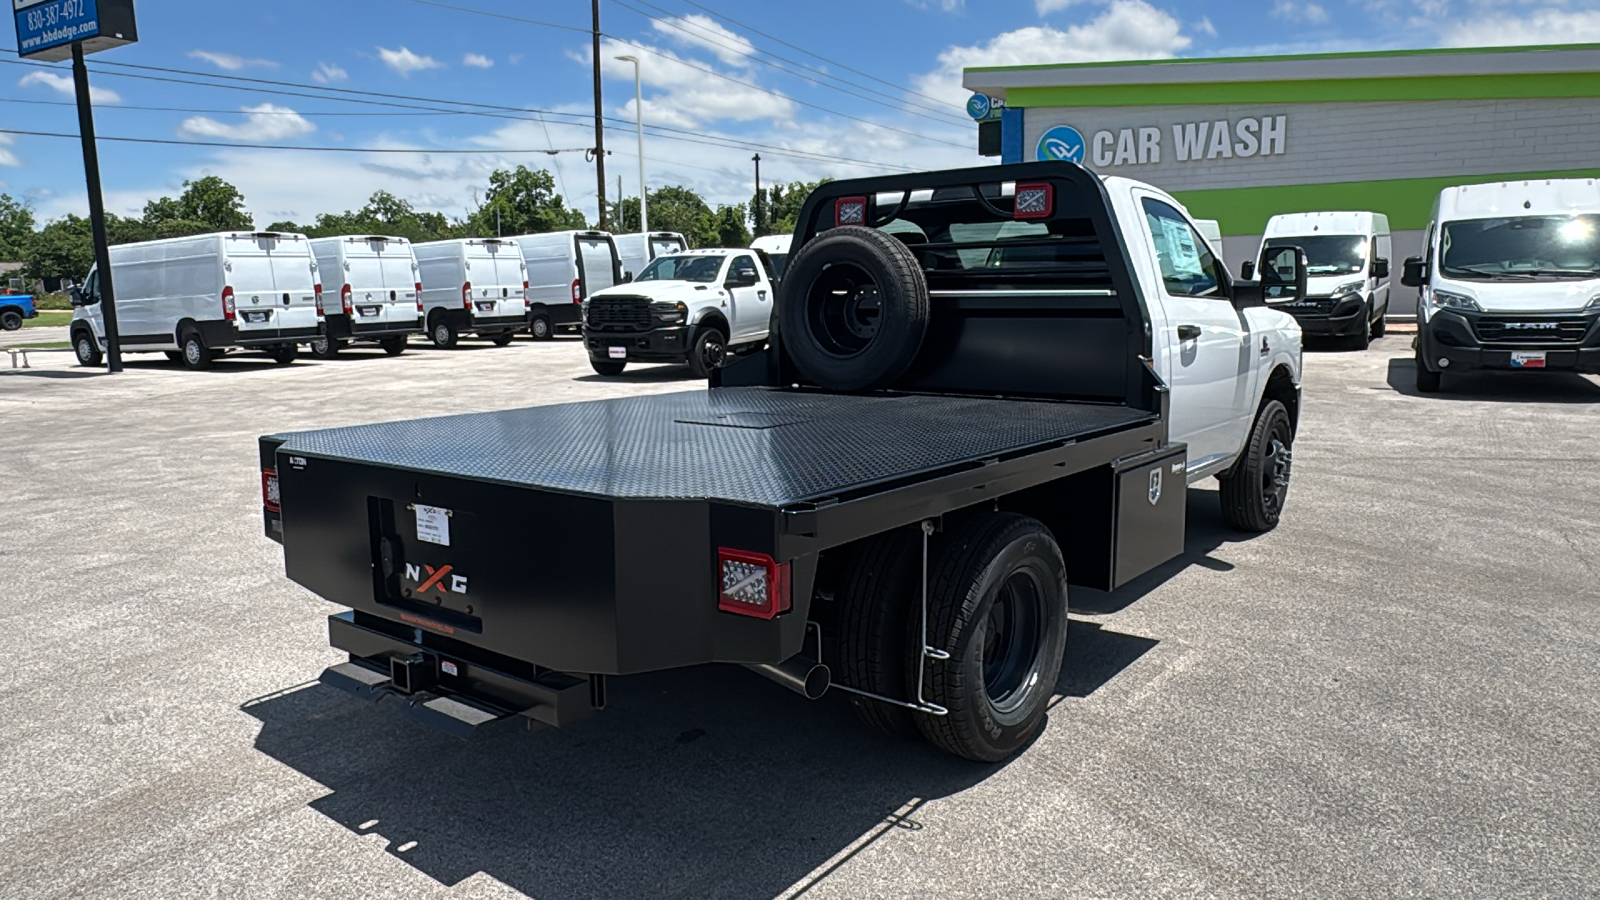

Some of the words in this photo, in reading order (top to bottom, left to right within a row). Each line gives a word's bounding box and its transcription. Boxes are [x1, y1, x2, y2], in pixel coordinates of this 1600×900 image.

[27, 0, 85, 31] 830-387-4972
[21, 20, 98, 49] www.bbdodge.com
[1092, 127, 1161, 168] CAR
[1172, 115, 1288, 162] WASH
[1504, 322, 1558, 330] RAM
[405, 562, 468, 594] NXG
